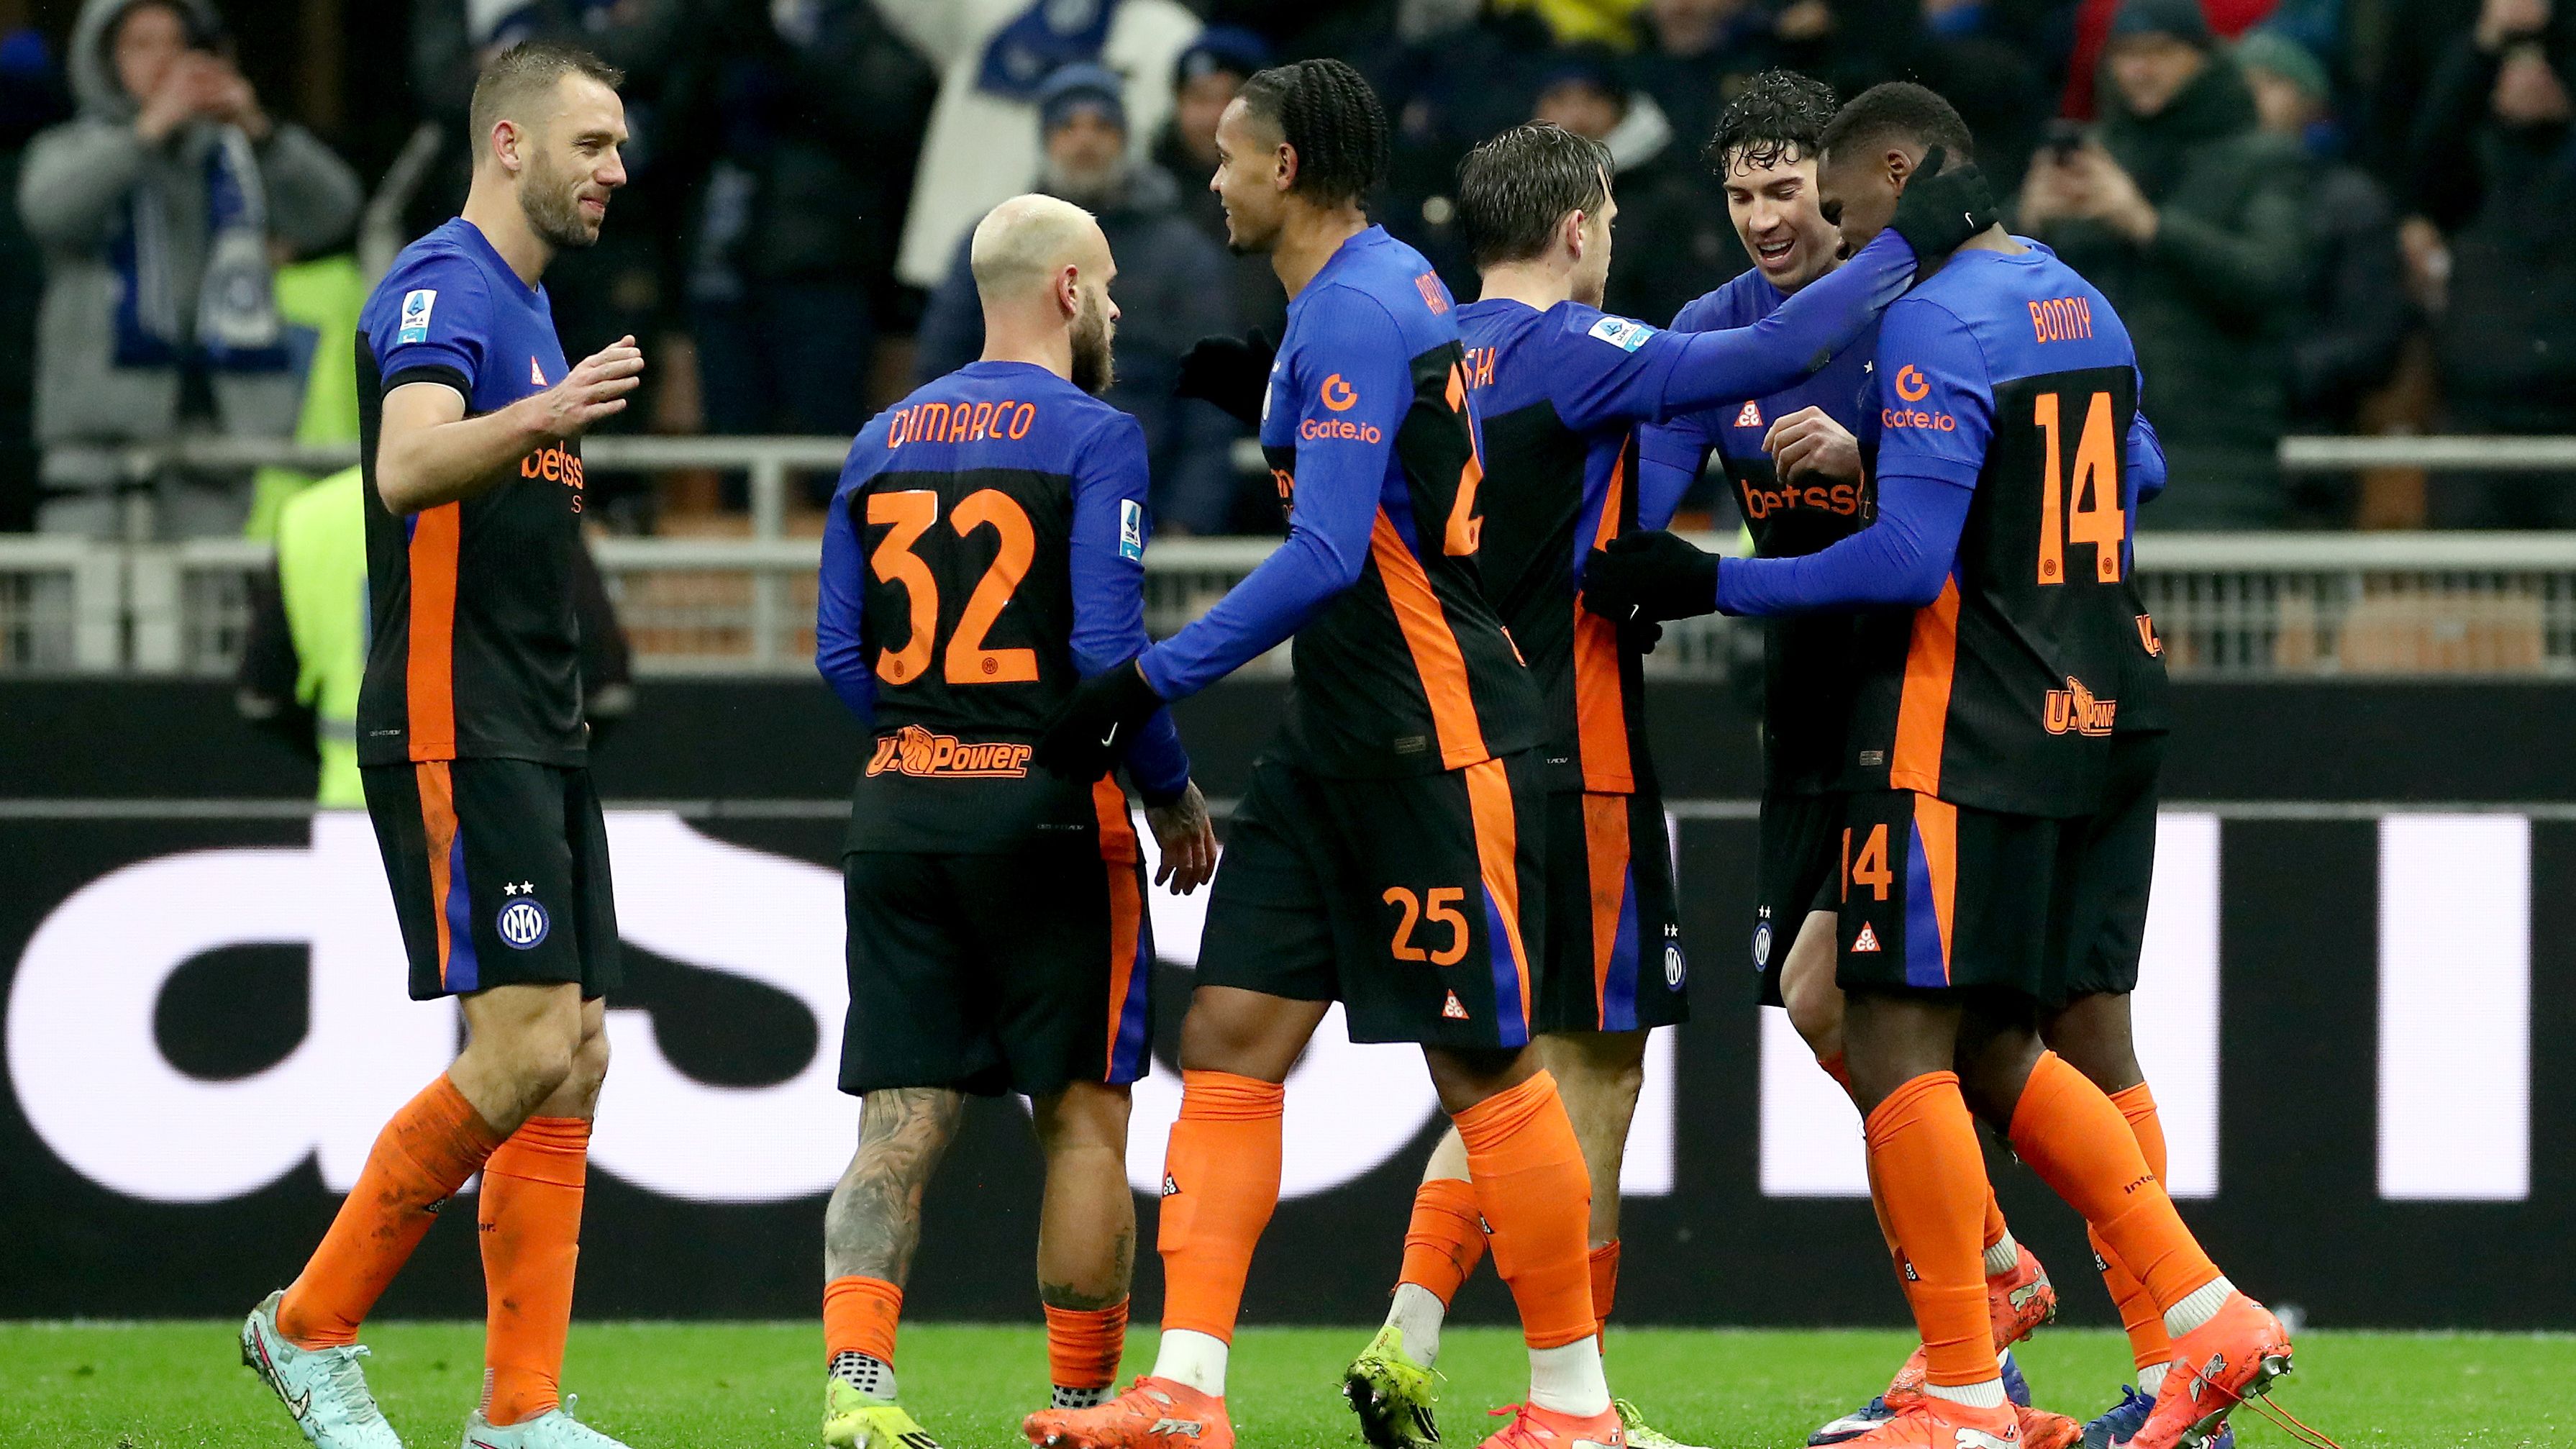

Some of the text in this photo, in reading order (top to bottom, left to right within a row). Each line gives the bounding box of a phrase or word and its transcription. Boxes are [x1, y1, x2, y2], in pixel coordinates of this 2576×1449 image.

[2029, 297, 2092, 343] BONNY
[888, 400, 1037, 449] DIMARCO
[1301, 418, 1381, 444] Gate.io
[1882, 407, 1956, 432] Gate.io
[2034, 391, 2124, 584] 14
[866, 488, 1040, 686] 32
[1842, 824, 1892, 904] 14
[1383, 886, 1469, 966] 25
